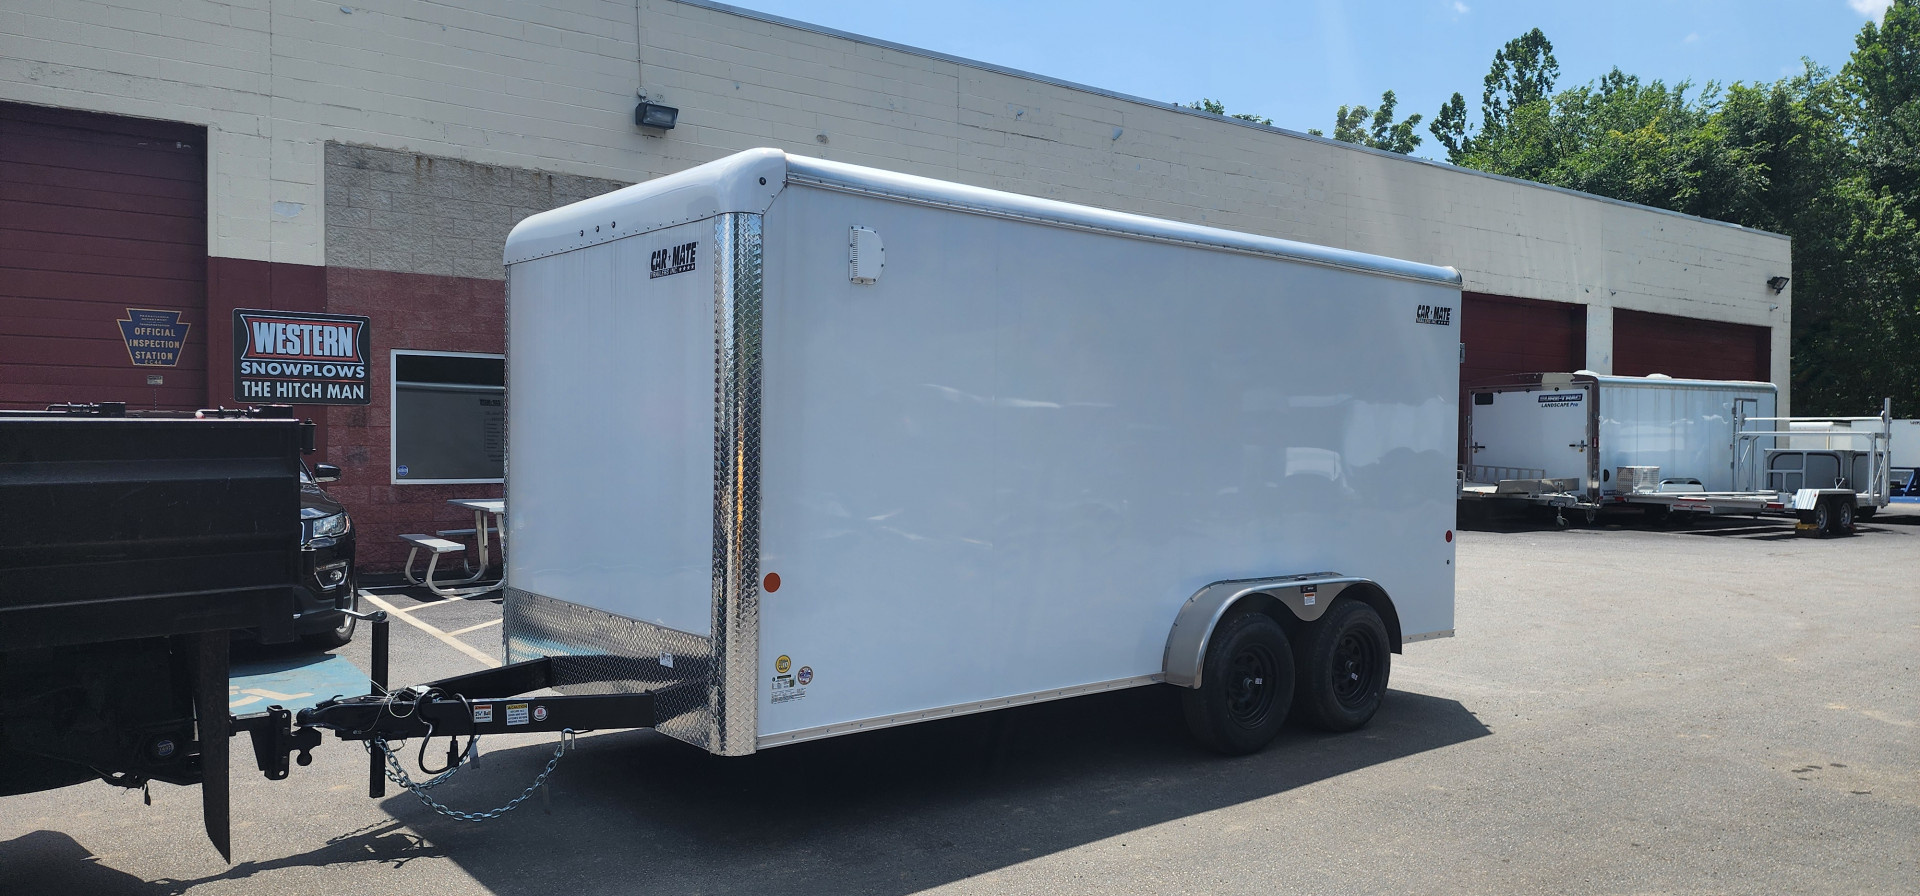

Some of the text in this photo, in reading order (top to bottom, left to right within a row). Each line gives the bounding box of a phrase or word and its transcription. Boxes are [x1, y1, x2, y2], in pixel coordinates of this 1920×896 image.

[650, 242, 697, 272] CAR MATE
[1417, 304, 1451, 320] CAR MATE
[134, 327, 176, 337] OFFICIAL
[252, 321, 353, 357] WESTERN
[129, 339, 180, 349] INSPECTION
[135, 351, 173, 360] STATION
[240, 361, 365, 378] SNOWPLOWS
[242, 380, 364, 400] THE HITCH MAN
